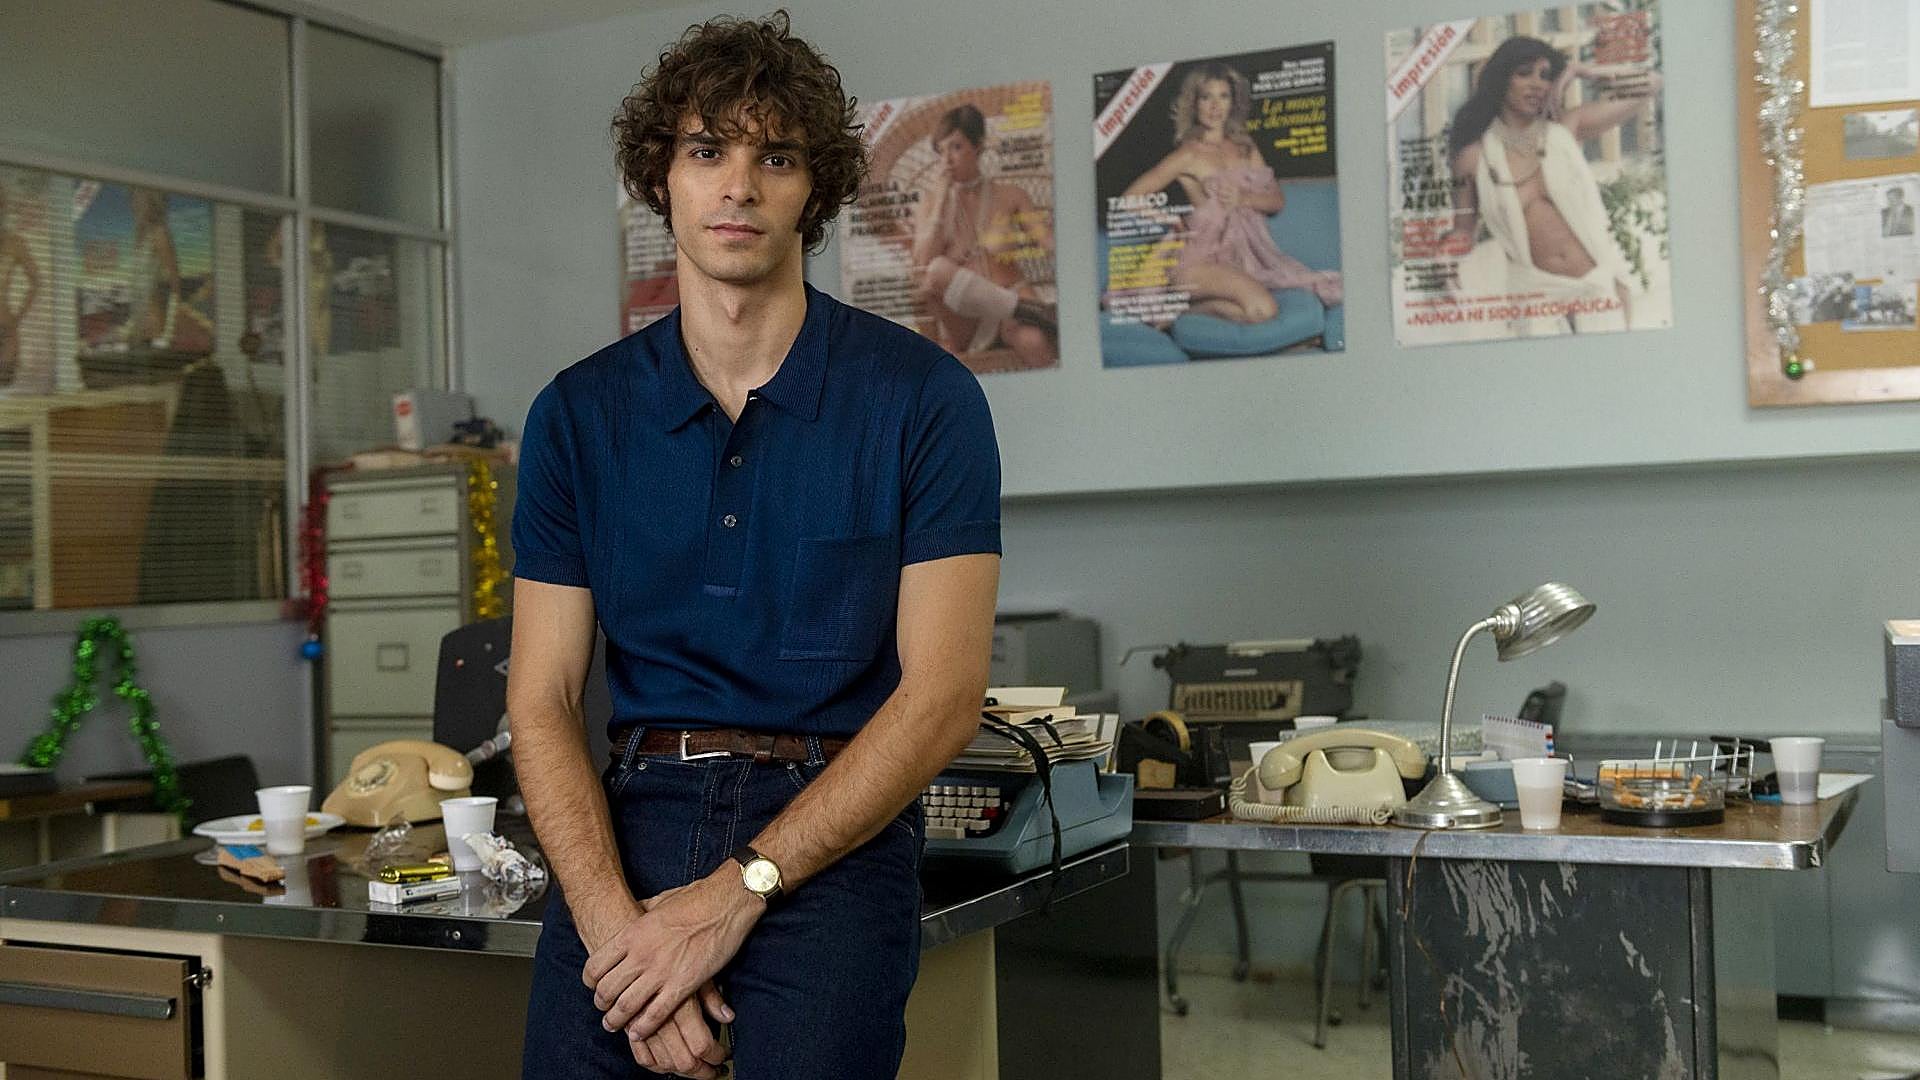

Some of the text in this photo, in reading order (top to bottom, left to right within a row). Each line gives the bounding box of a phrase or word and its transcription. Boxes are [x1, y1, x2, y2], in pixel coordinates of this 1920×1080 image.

[1388, 26, 1456, 99] impresión
[1095, 67, 1155, 137] impresión
[1106, 191, 1169, 212] TABACO
